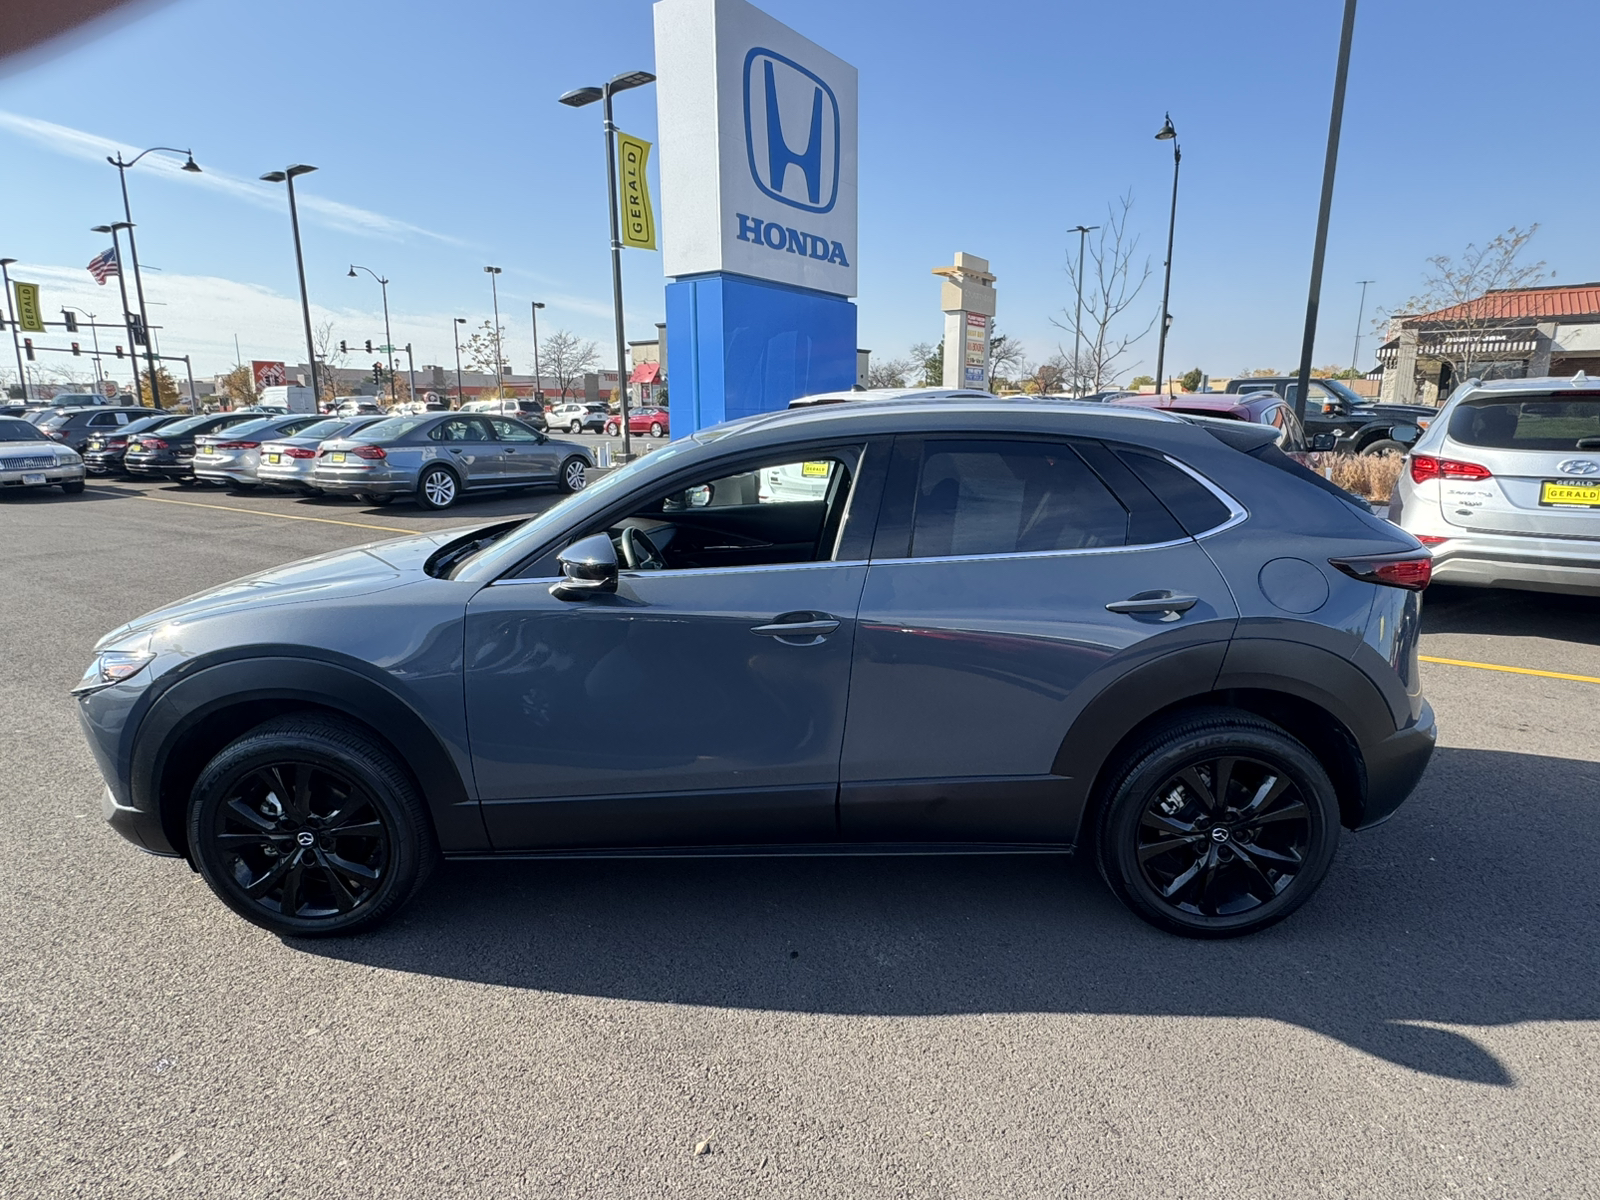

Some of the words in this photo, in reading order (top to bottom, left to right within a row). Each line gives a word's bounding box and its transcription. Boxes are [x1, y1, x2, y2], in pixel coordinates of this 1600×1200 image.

[627, 151, 643, 234] GERALD
[736, 212, 850, 268] HONDA
[22, 288, 35, 327] GERALD
[1550, 490, 1597, 498] GERALD
